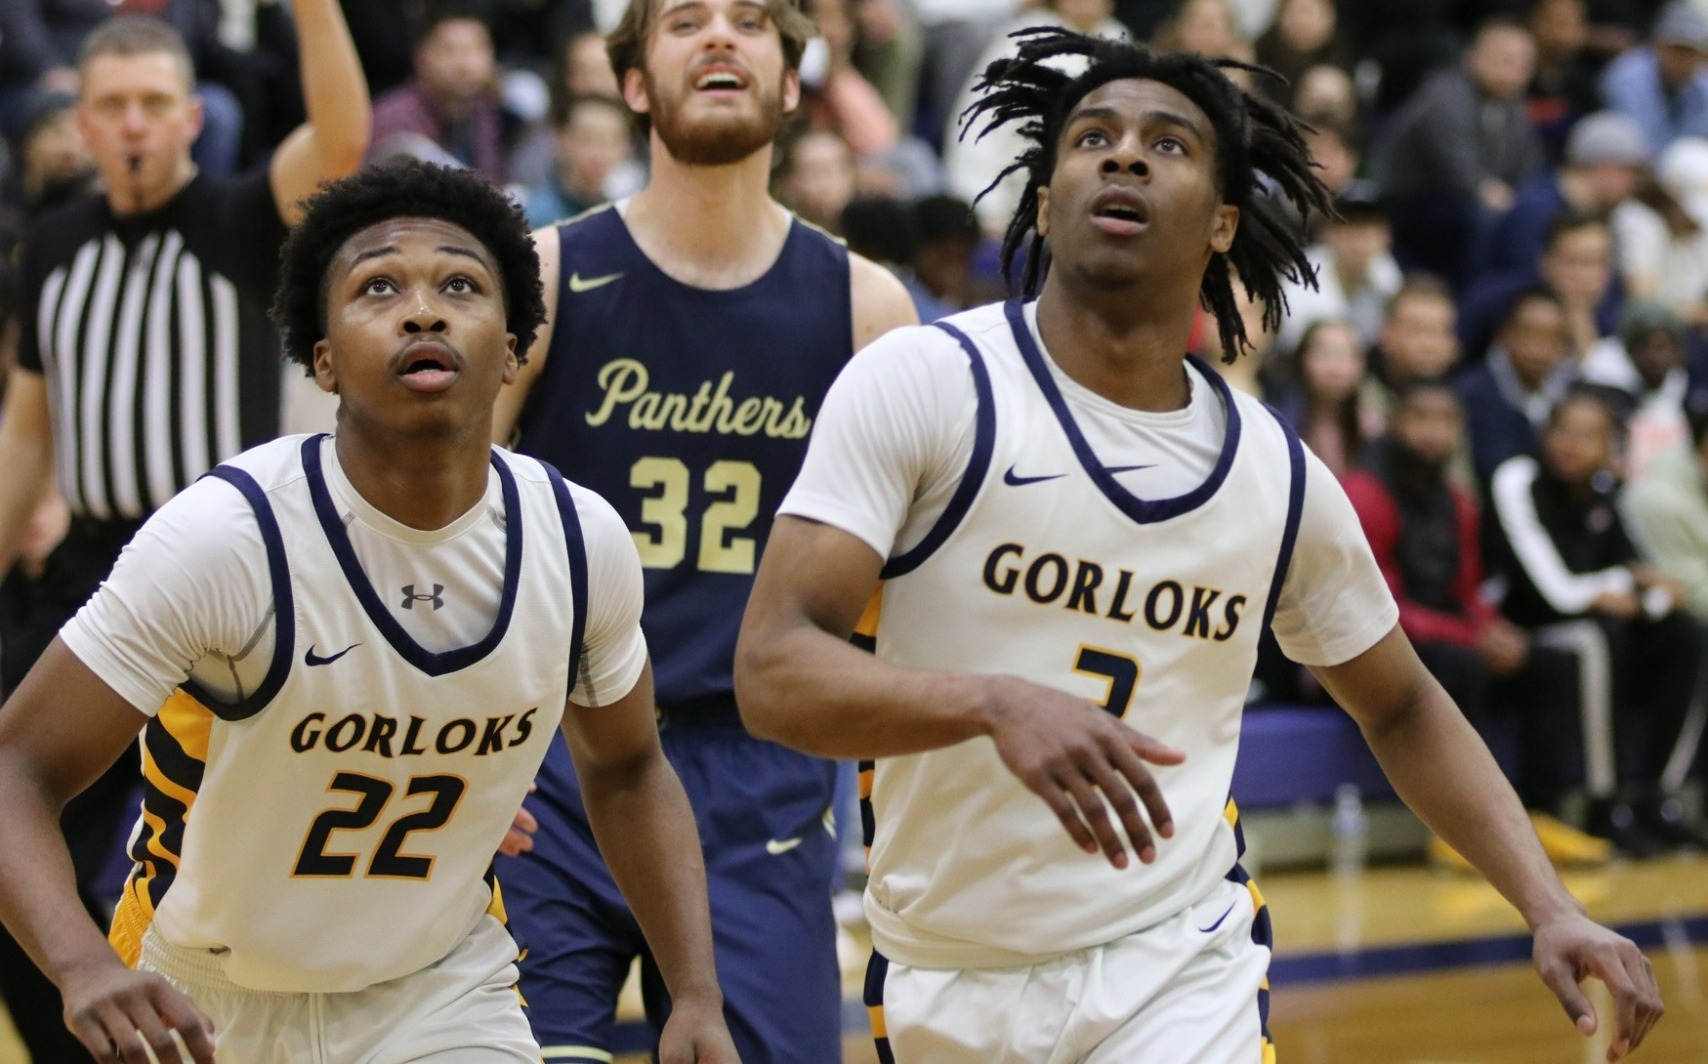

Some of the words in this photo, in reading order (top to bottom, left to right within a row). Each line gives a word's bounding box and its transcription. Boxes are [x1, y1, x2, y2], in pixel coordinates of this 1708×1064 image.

[585, 358, 811, 439] Panthers
[630, 456, 761, 574] 32
[982, 542, 1247, 642] GORLOKS
[289, 707, 538, 758] GORLOKS
[289, 769, 469, 882] 22
